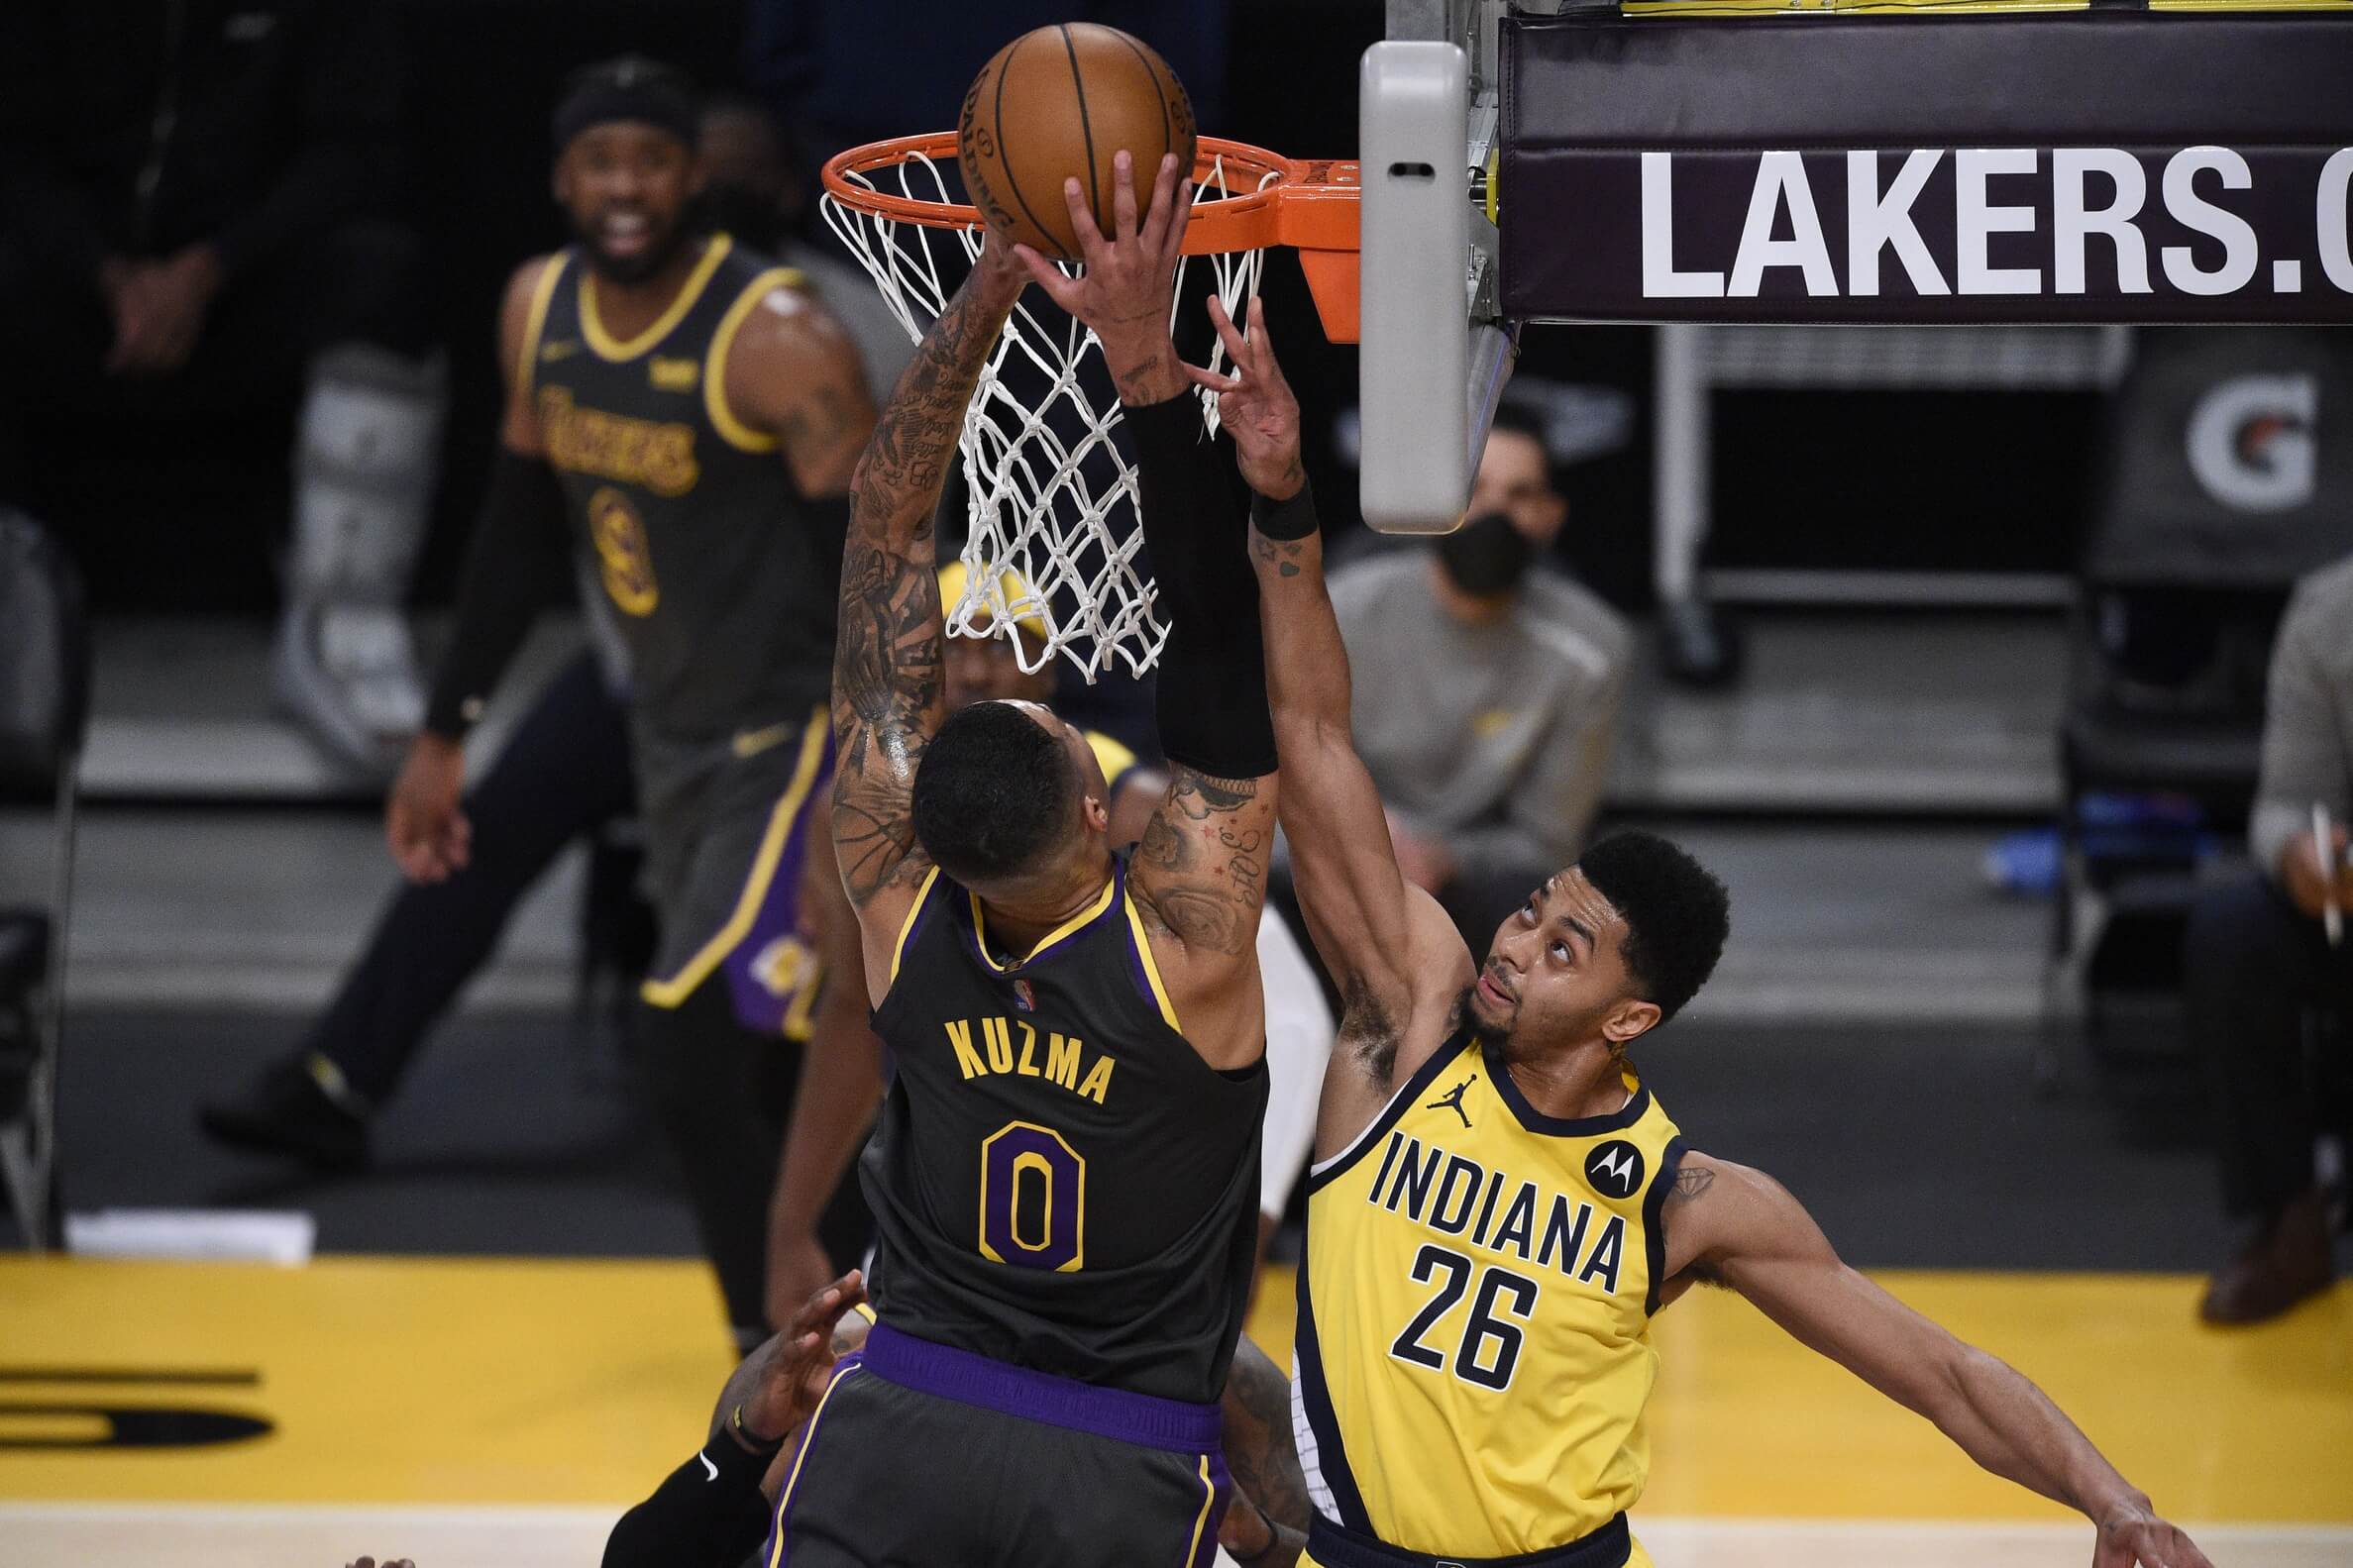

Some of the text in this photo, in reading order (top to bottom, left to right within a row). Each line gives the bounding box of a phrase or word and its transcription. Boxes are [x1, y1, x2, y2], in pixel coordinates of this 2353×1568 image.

[2187, 373, 2316, 509] G
[943, 1016, 1117, 1105] KUZMA
[979, 1119, 1086, 1273] 0
[1366, 1130, 1626, 1297] INDIANA
[1389, 1242, 1541, 1394] 26
